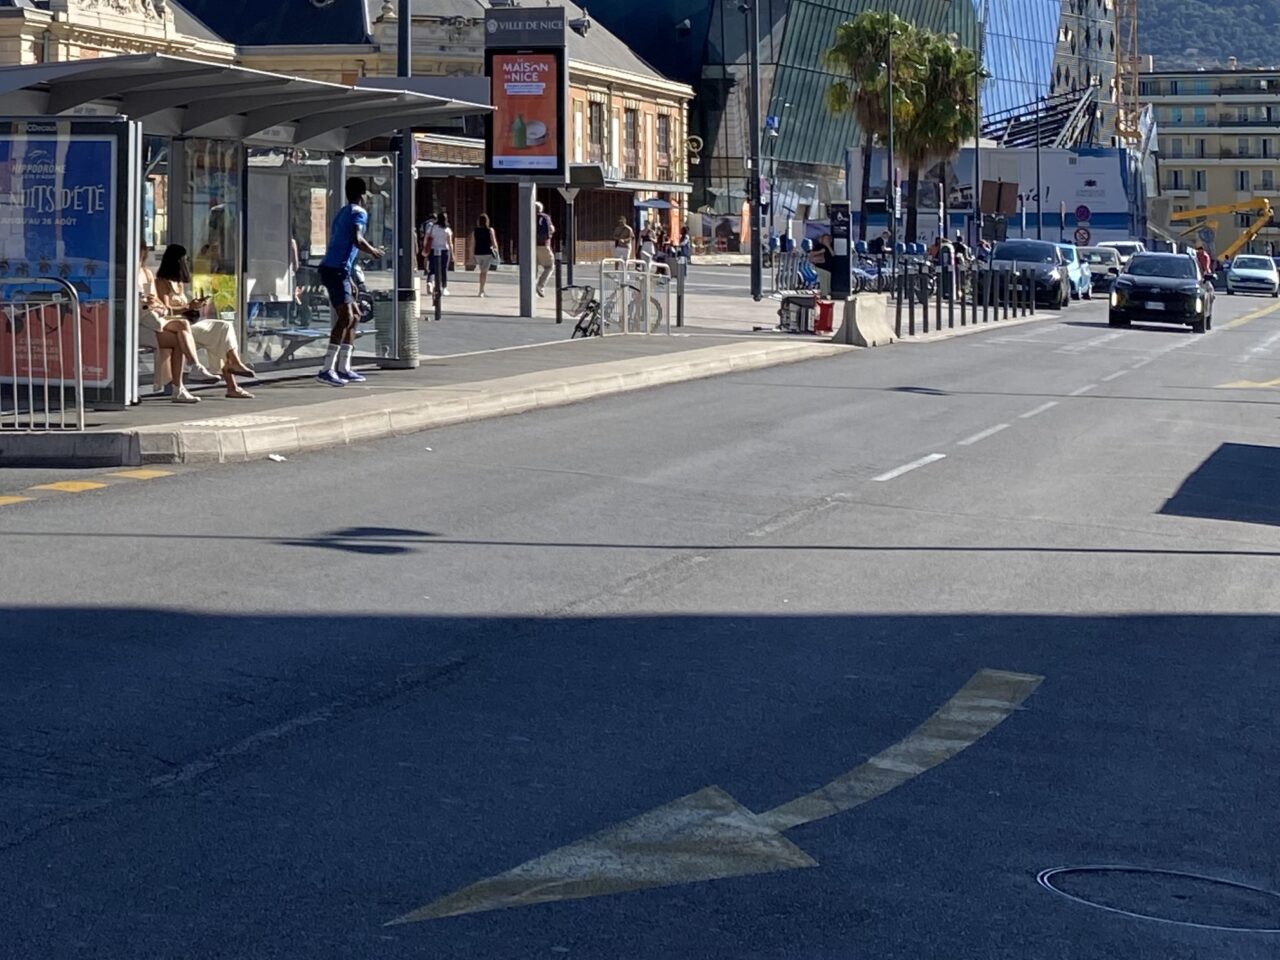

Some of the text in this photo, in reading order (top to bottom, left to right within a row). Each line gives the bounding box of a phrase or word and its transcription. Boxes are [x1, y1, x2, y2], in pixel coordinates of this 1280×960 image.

[499, 20, 564, 30] VILLE DE NICE
[502, 62, 549, 72] MAISON
[511, 72, 539, 82] NICE
[10, 184, 56, 214] NUITS
[55, 217, 78, 226] AOÛT
